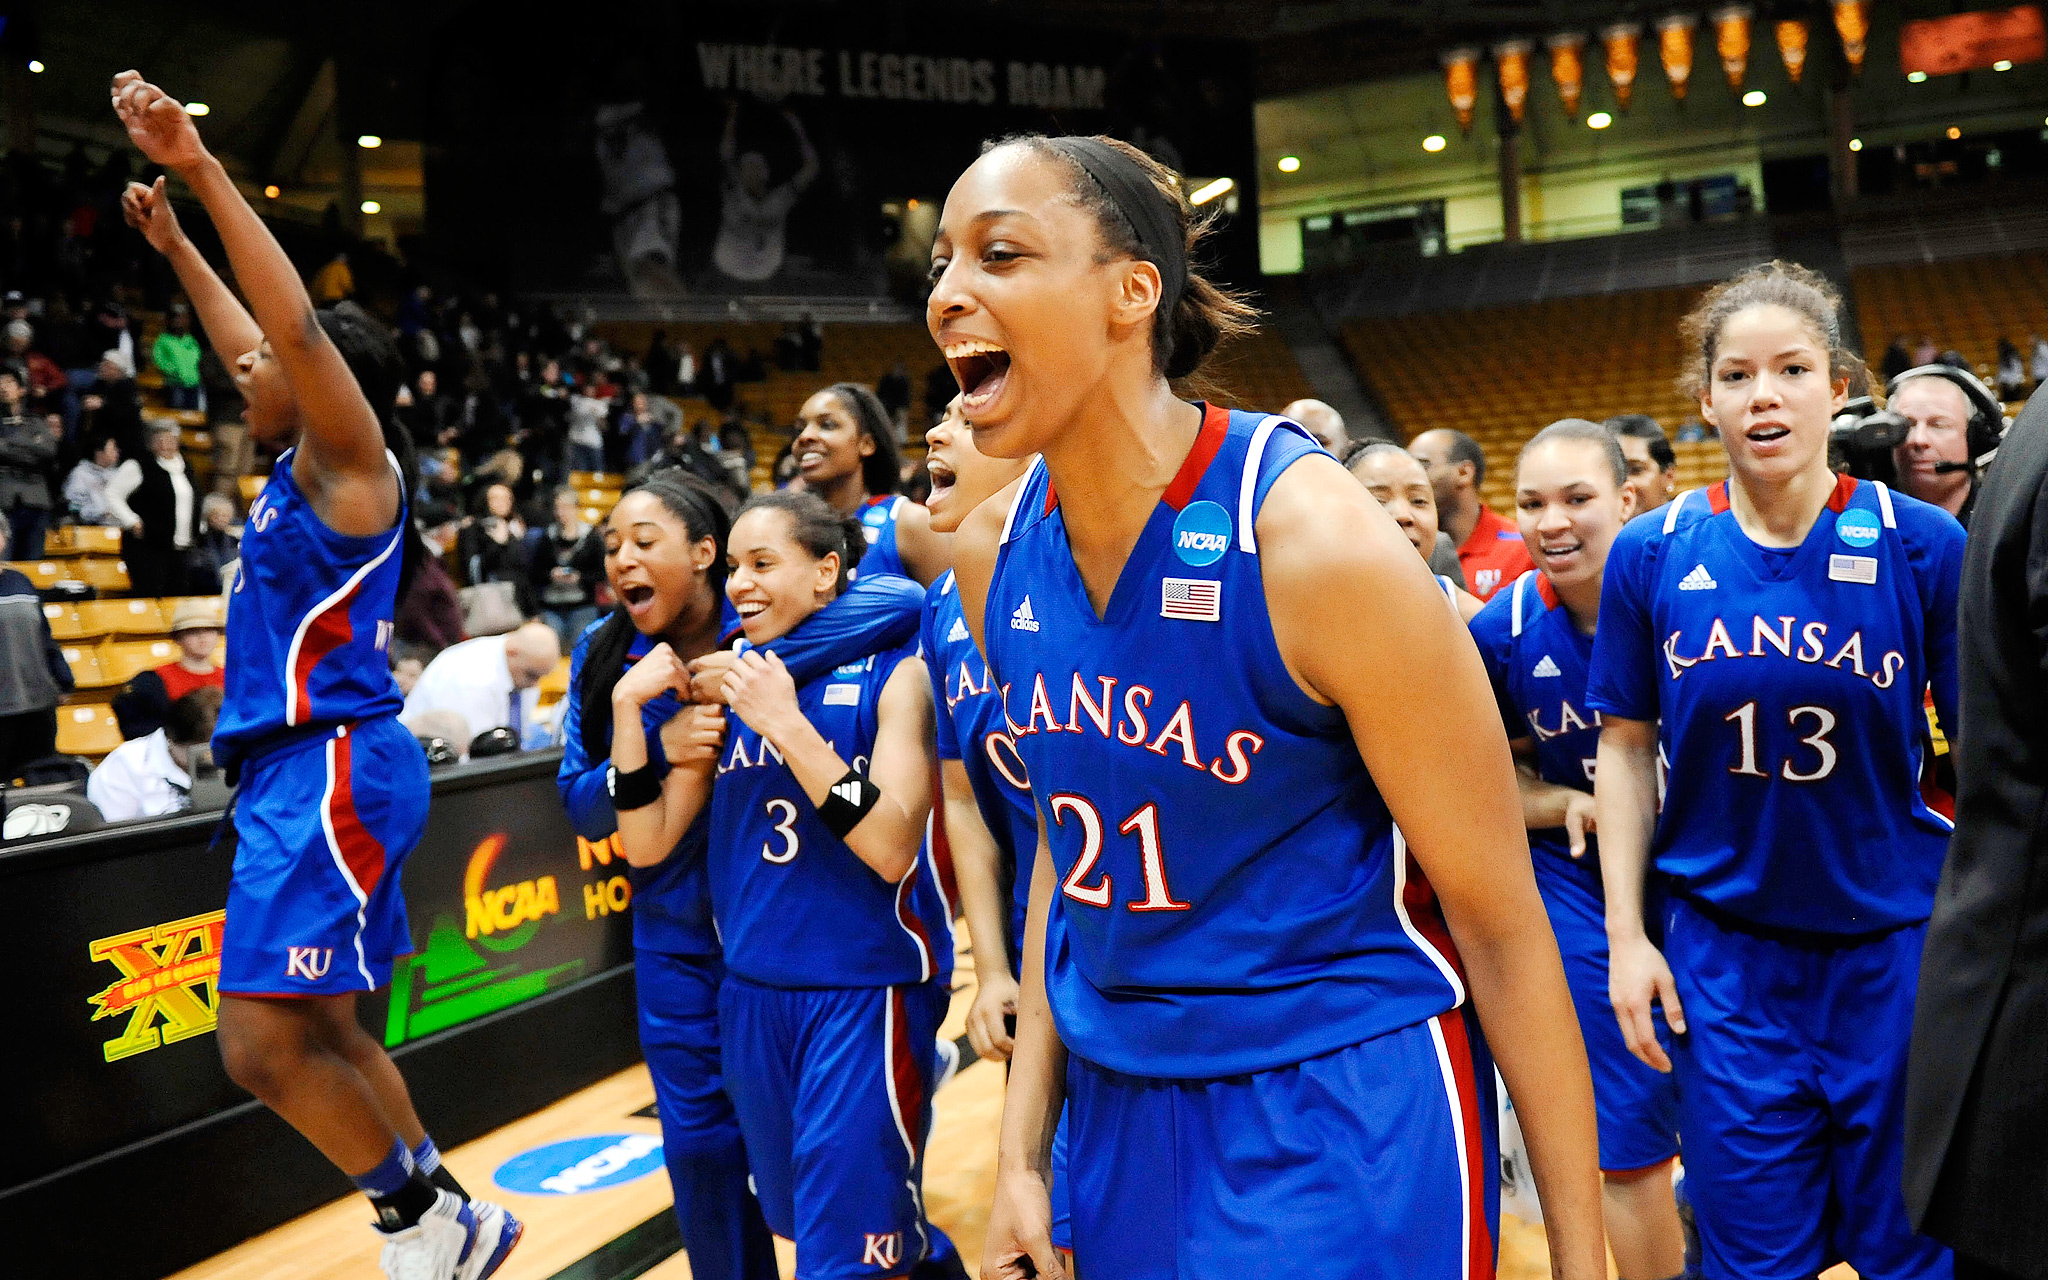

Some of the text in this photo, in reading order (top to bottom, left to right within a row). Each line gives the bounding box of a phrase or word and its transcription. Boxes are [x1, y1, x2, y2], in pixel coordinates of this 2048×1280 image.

[698, 41, 1106, 109] WHERE LEGENDS ROAM
[1177, 529, 1227, 552] NCAA
[1840, 524, 1879, 540] NCAA
[1679, 579, 1717, 591] adidas
[1010, 617, 1040, 632] adidas
[1662, 615, 1905, 689] KANSAS
[1001, 672, 1265, 784] KANSAS
[1725, 701, 1838, 781] 13
[762, 798, 800, 864] 3
[1050, 792, 1191, 912] 21
[465, 875, 560, 940] NCAA
[284, 946, 334, 981] KU
[863, 1231, 904, 1269] KU
